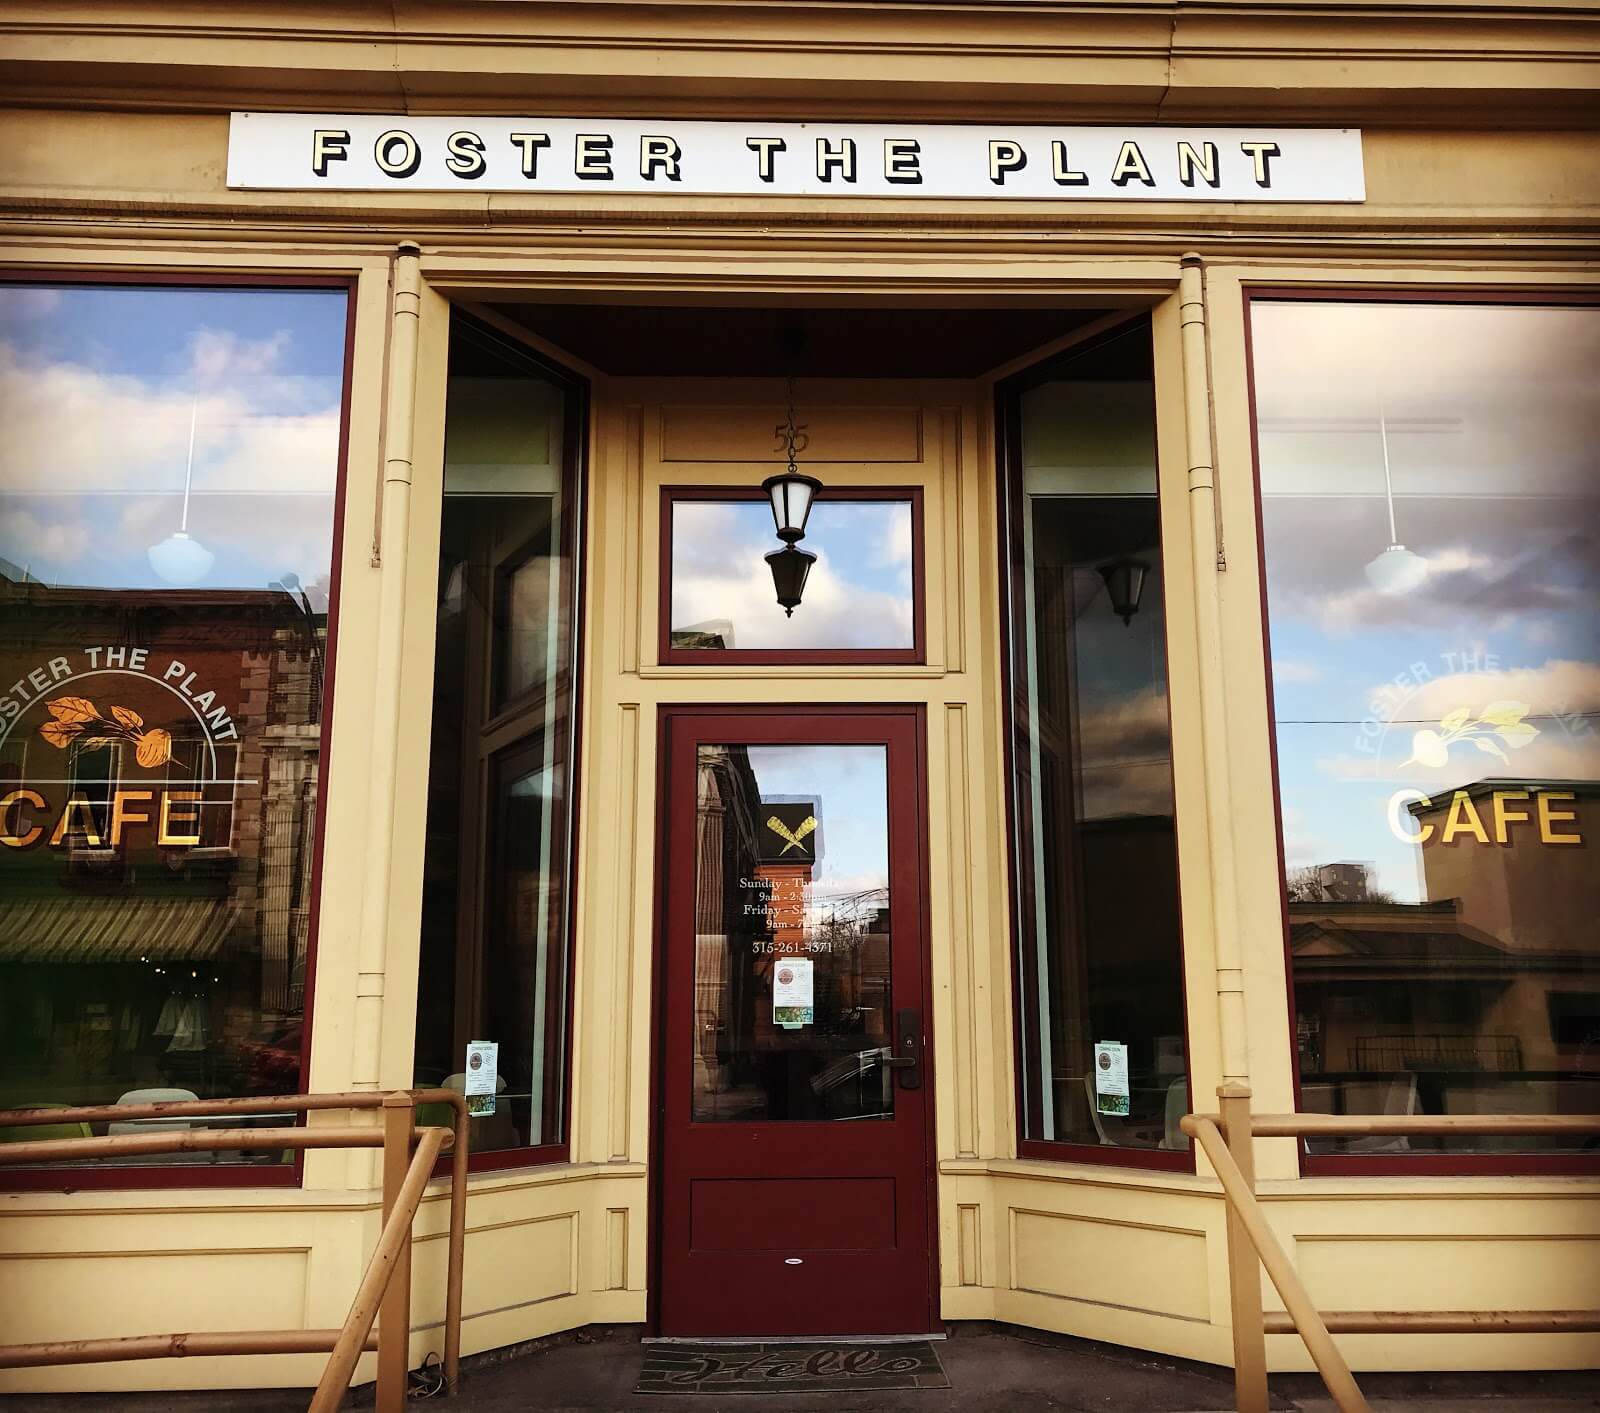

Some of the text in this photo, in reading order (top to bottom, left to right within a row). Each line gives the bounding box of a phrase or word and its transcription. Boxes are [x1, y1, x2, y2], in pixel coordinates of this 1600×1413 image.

[312, 129, 1281, 189] FOSTER THE PLANT
[773, 423, 810, 453] 55
[1440, 651, 1501, 674] THE
[85, 646, 149, 671] THE
[163, 660, 239, 743] PLANT
[0, 788, 203, 847] CAFE
[1388, 788, 1583, 846] CAFE
[739, 877, 783, 891] Sunday
[758, 891, 780, 902] 9am
[743, 904, 782, 918] Friday
[765, 919, 788, 929] 9am
[752, 941, 833, 953] 315-261-4371
[663, 1348, 922, 1384] Hello
